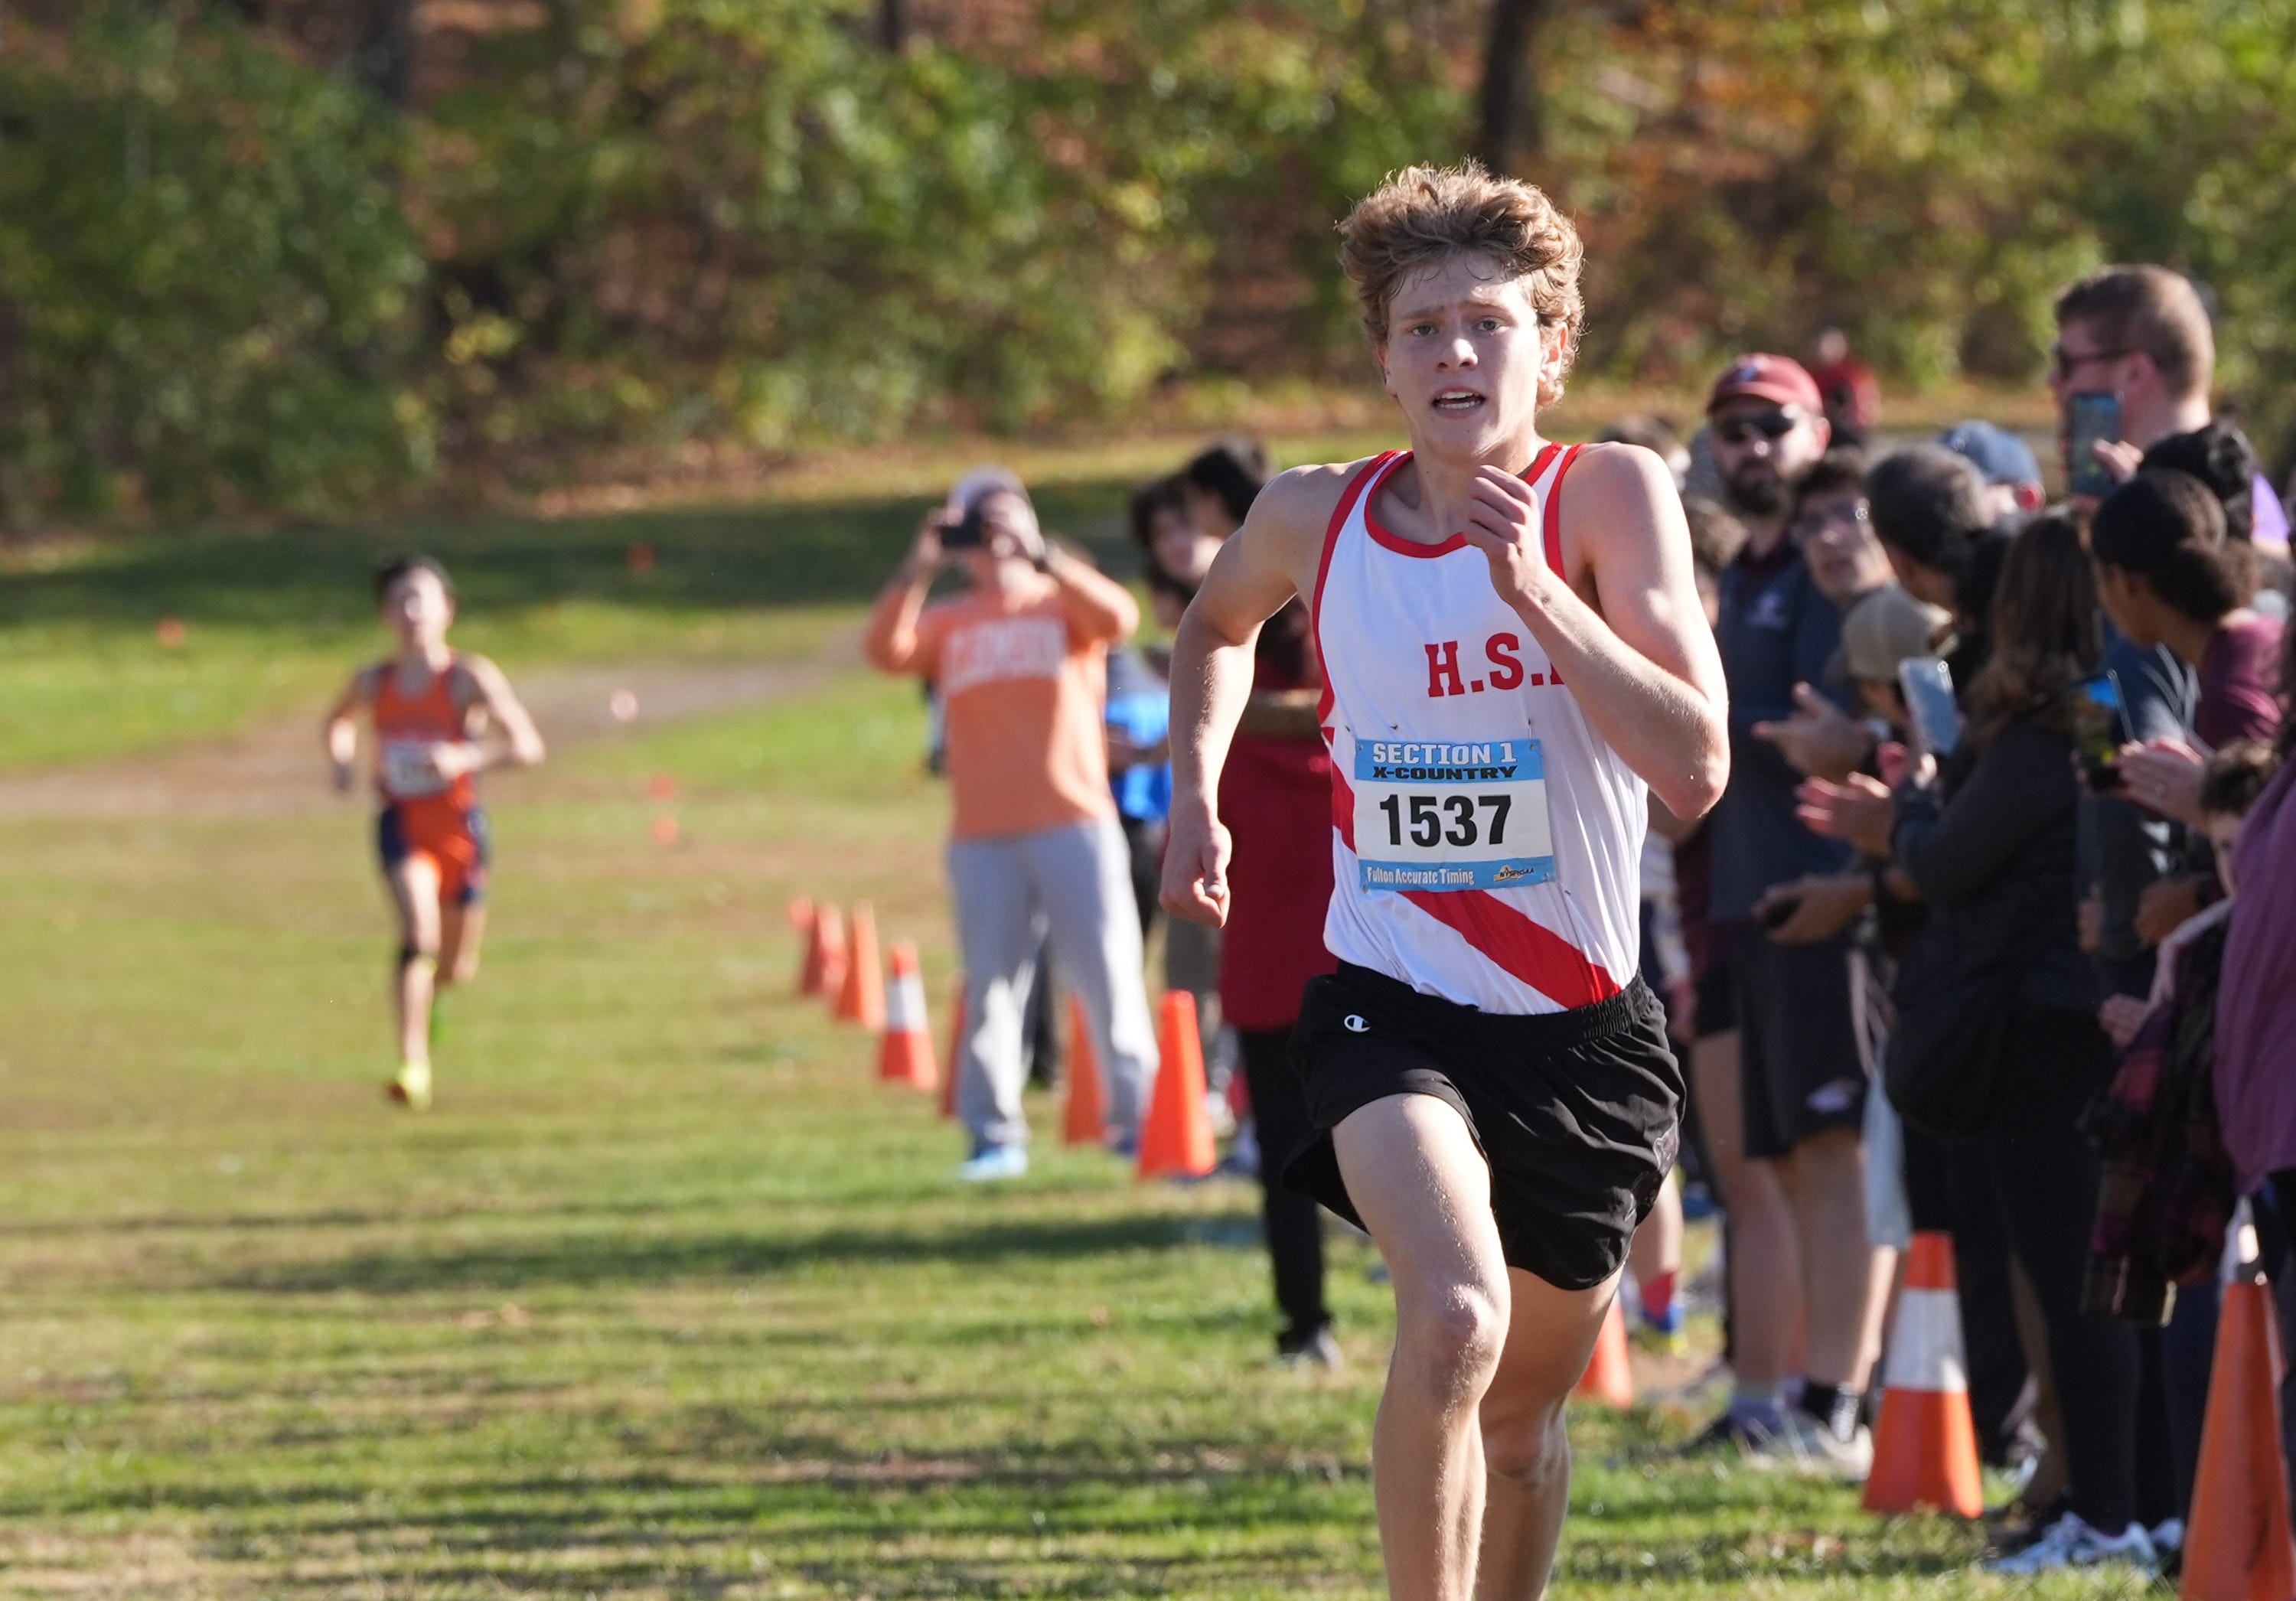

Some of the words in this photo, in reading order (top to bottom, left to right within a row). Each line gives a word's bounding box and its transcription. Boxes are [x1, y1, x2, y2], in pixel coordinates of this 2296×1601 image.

[1372, 742, 1492, 765] SECTION
[1500, 741, 1518, 764] 1
[1372, 765, 1518, 781] X-COUNTRY
[1379, 794, 1512, 848] 1537
[1367, 866, 1394, 883] Fulton
[1395, 868, 1438, 885] Accurate
[1439, 868, 1475, 885] Timing
